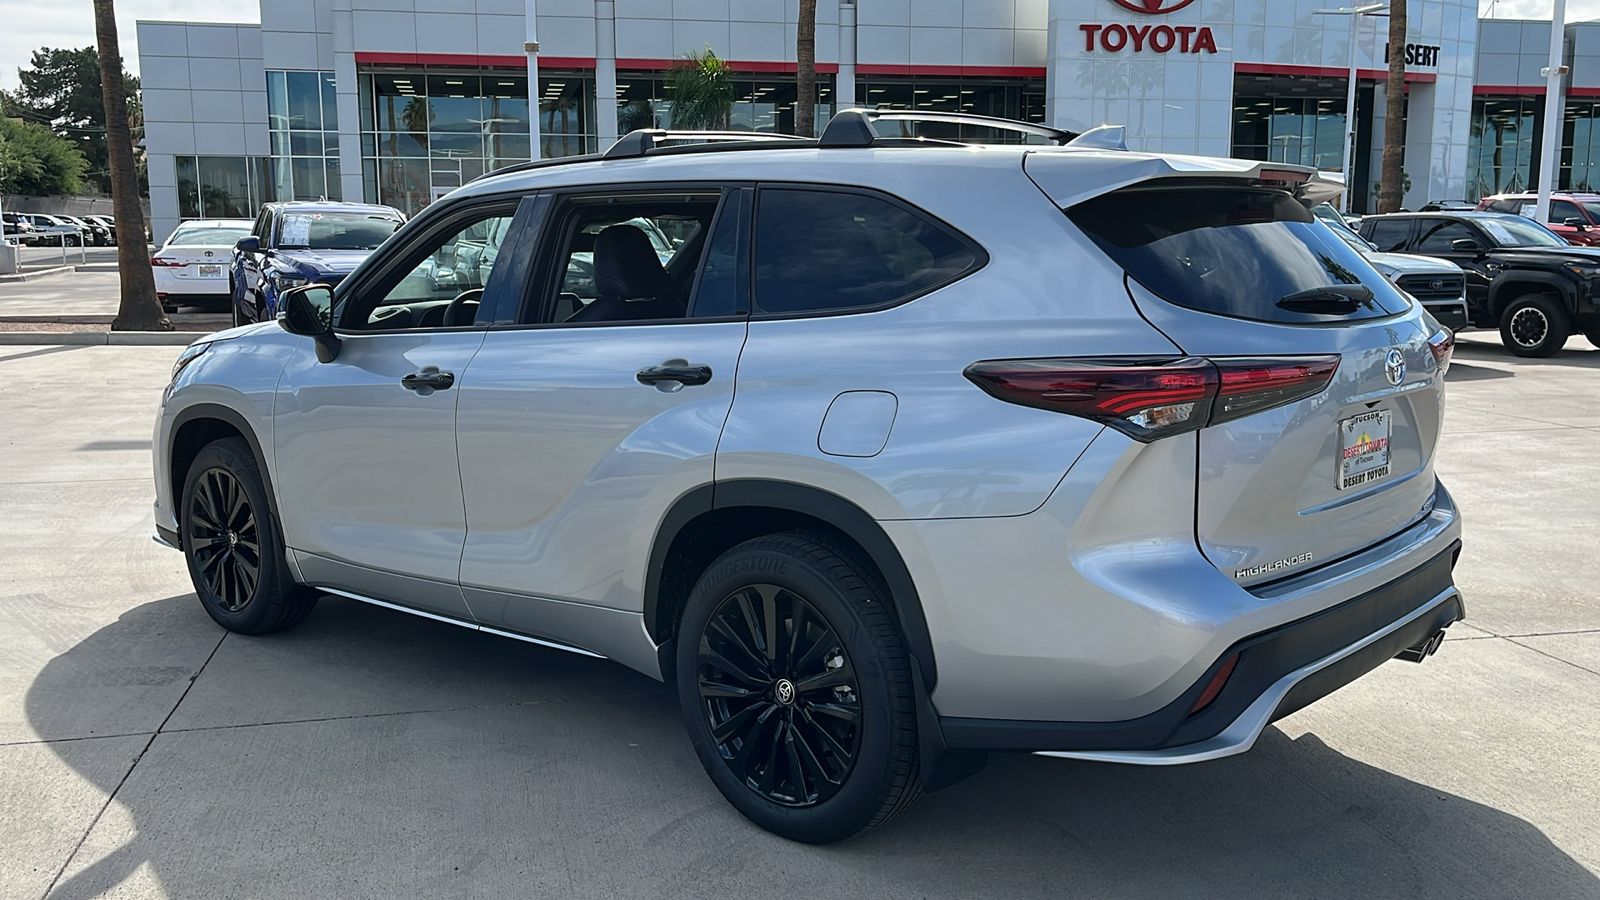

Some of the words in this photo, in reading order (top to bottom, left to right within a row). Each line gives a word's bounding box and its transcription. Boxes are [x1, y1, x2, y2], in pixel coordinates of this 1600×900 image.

[1079, 24, 1217, 53] TOYOTA
[1384, 43, 1440, 67] SERT
[1355, 412, 1379, 423] TUCSON
[1343, 443, 1364, 460] DESERT
[1365, 437, 1387, 453] TOYOTA
[1343, 473, 1366, 488] DESERT
[1366, 465, 1389, 482] TOYOTA
[1234, 551, 1313, 578] HIGHLANDER
